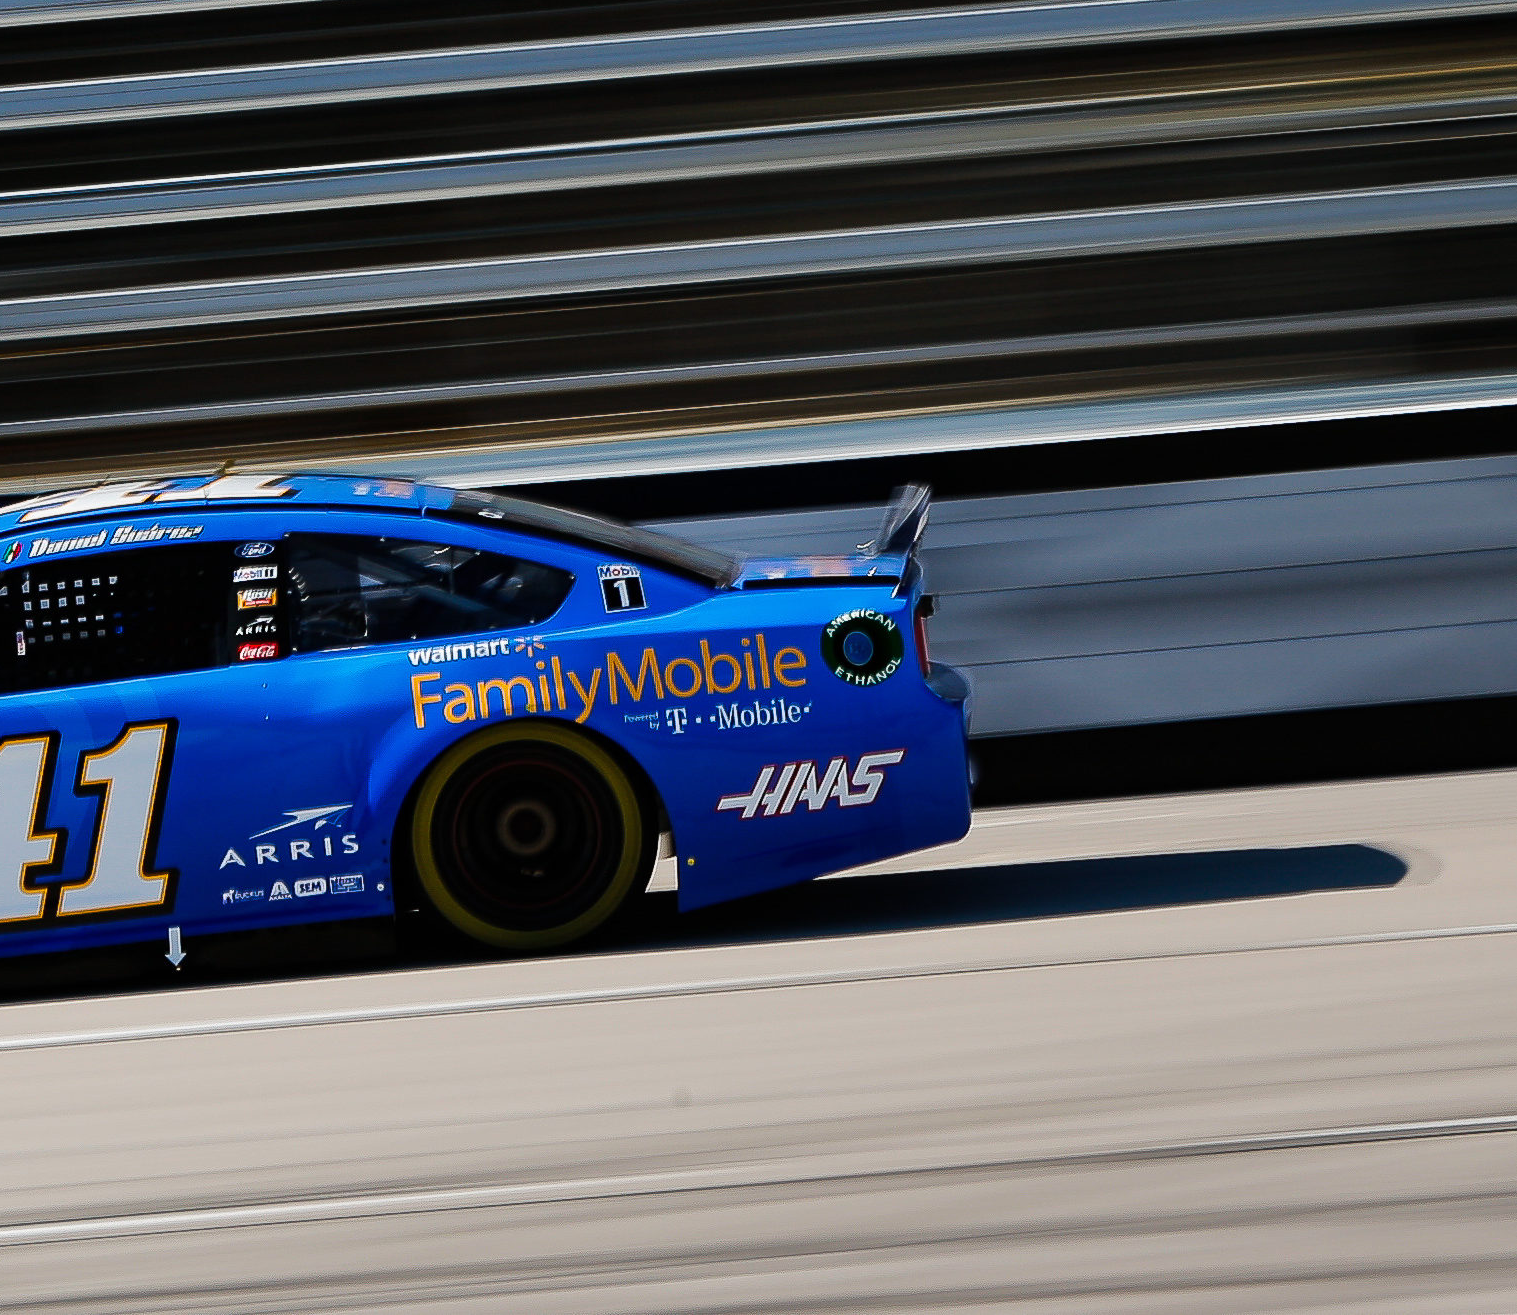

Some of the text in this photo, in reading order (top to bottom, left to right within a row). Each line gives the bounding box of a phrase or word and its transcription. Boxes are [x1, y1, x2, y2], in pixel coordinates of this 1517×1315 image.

[241, 543, 267, 556] Ford
[613, 579, 630, 607] 1
[236, 625, 277, 636] ARRIS
[826, 608, 896, 637] AMERICAN
[408, 638, 510, 666] Walmart
[835, 657, 902, 685] ETHANOL
[716, 749, 906, 819] HAAS
[219, 834, 359, 870] ARRIS
[298, 880, 323, 894] SEM
